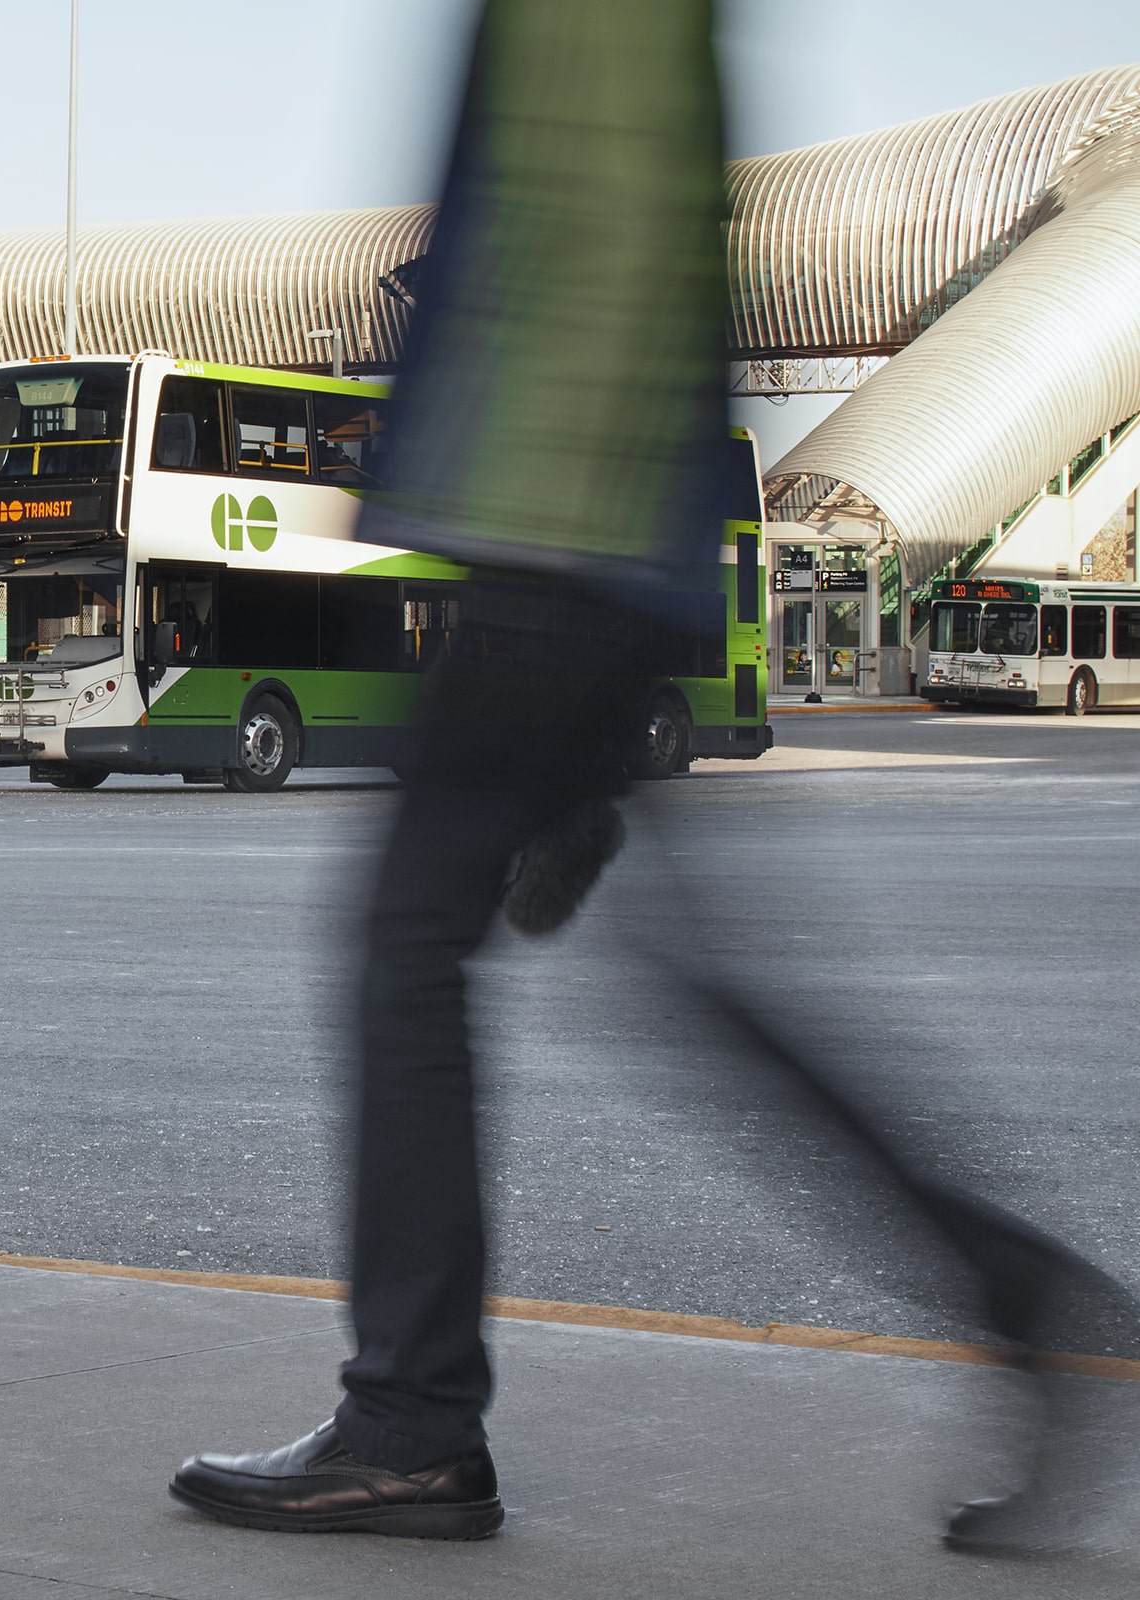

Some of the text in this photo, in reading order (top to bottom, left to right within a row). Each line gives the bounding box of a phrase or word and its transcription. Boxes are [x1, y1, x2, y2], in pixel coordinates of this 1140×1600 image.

[31, 390, 53, 401] 8144
[25, 501, 72, 518] TRANSIT
[211, 492, 278, 552] GO
[795, 555, 808, 563] A4
[952, 584, 966, 597] 120
